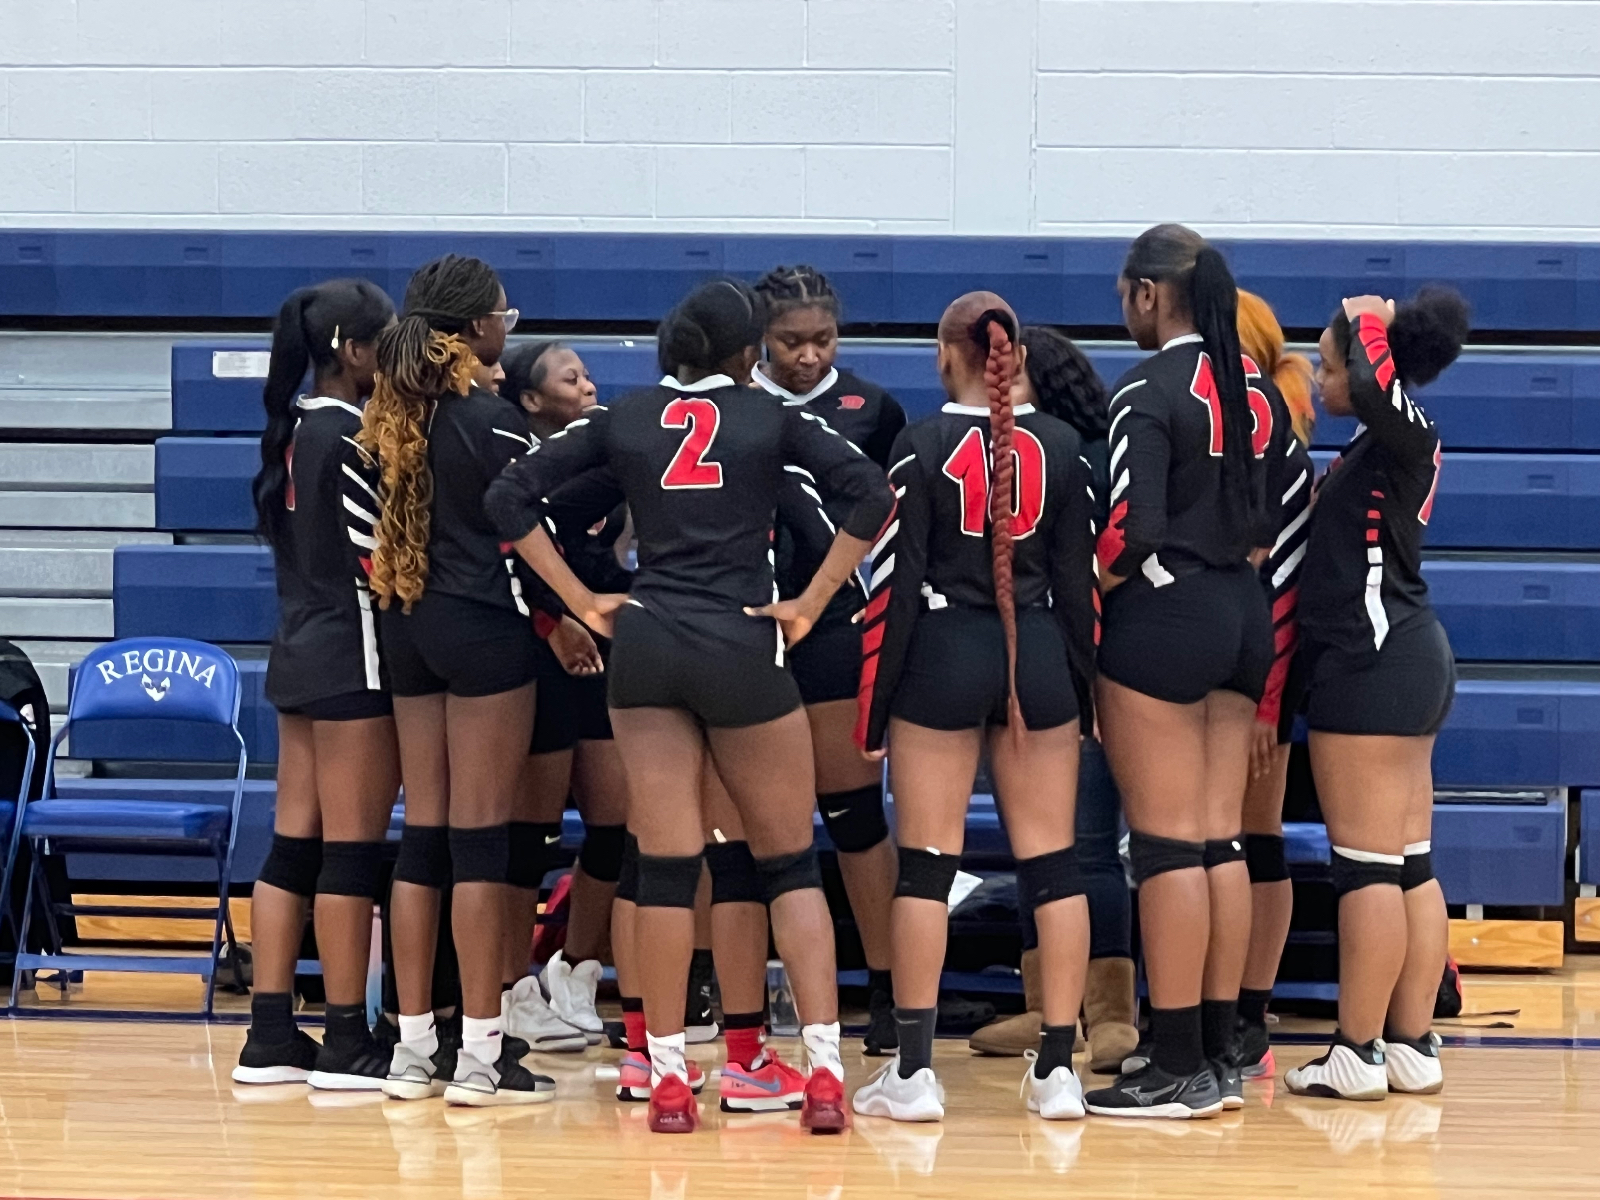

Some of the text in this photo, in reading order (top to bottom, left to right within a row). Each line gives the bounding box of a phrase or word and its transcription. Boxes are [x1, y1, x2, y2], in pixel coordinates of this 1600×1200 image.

[660, 397, 724, 490] 2
[941, 426, 1047, 540] 10
[95, 648, 217, 689] REGINA
